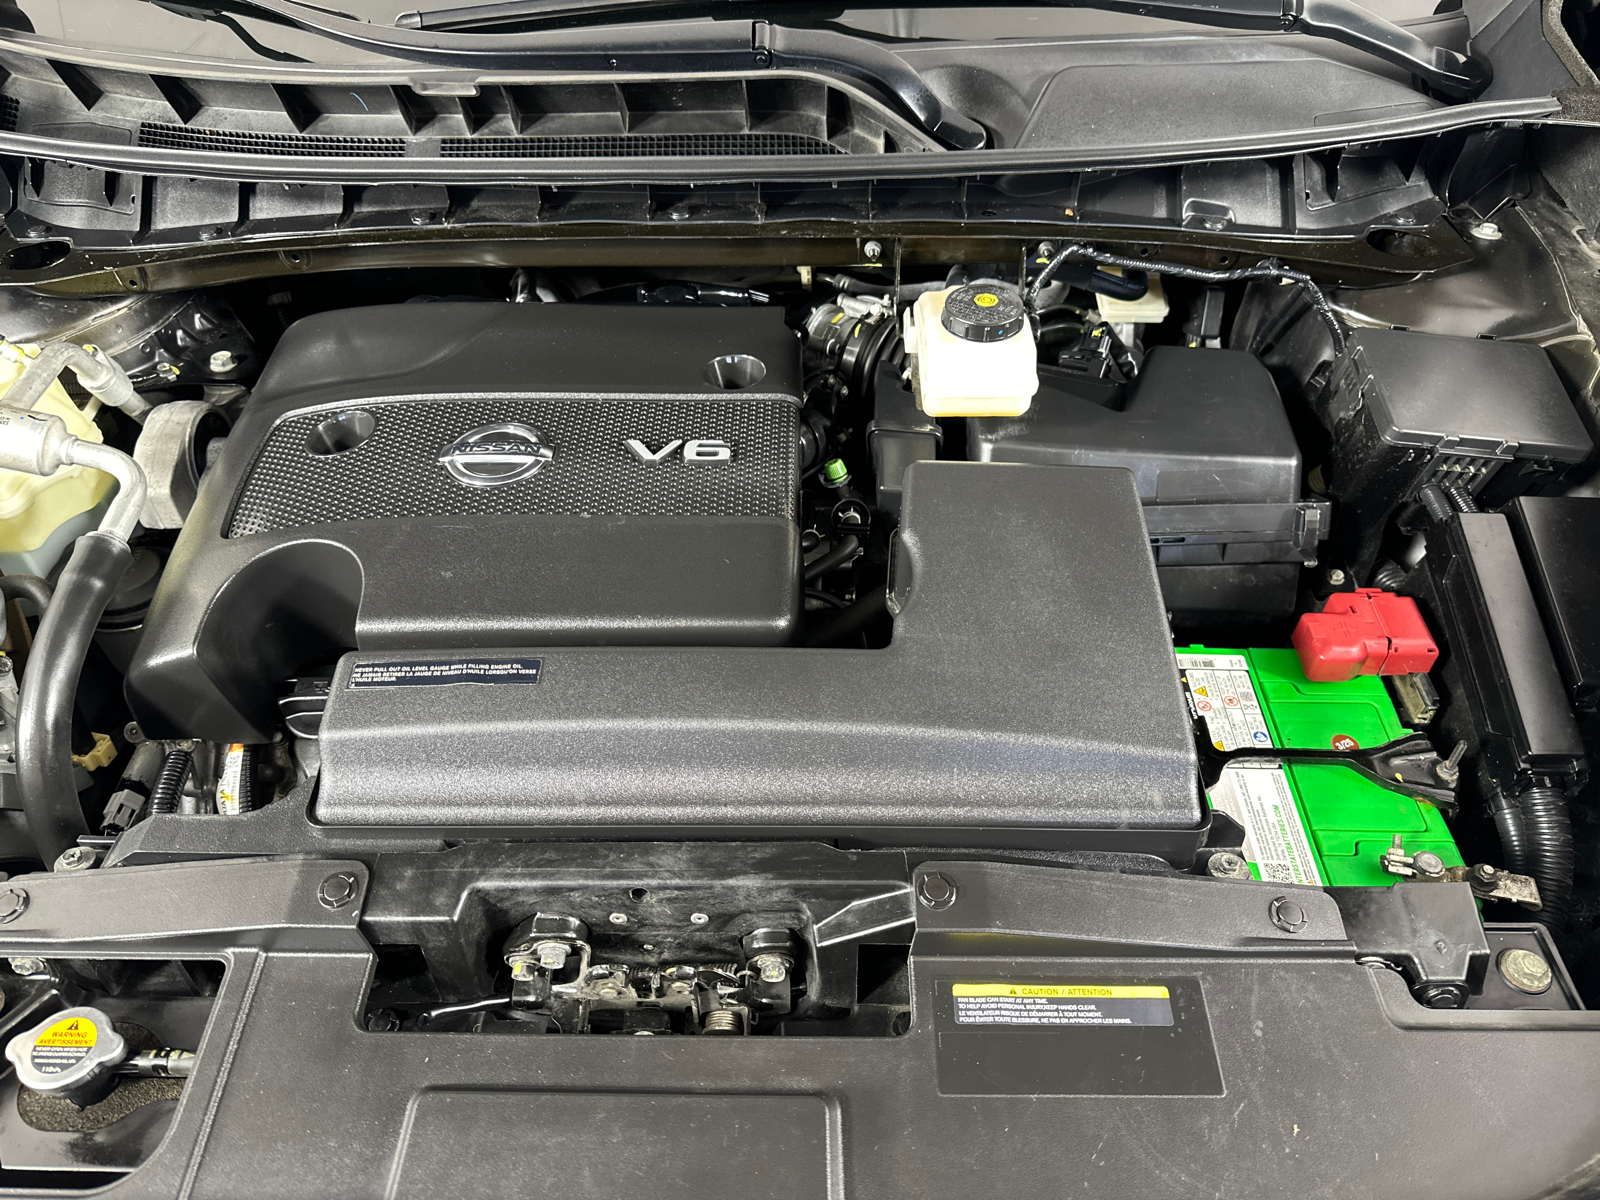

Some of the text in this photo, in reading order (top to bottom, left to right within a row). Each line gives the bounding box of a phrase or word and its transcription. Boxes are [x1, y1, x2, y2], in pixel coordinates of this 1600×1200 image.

[450, 442, 542, 454] NISSAN
[624, 439, 731, 466] V6
[1335, 738, 1354, 750] 3/25
[1272, 804, 1304, 884] NTERSTATEBATTERIES.COM
